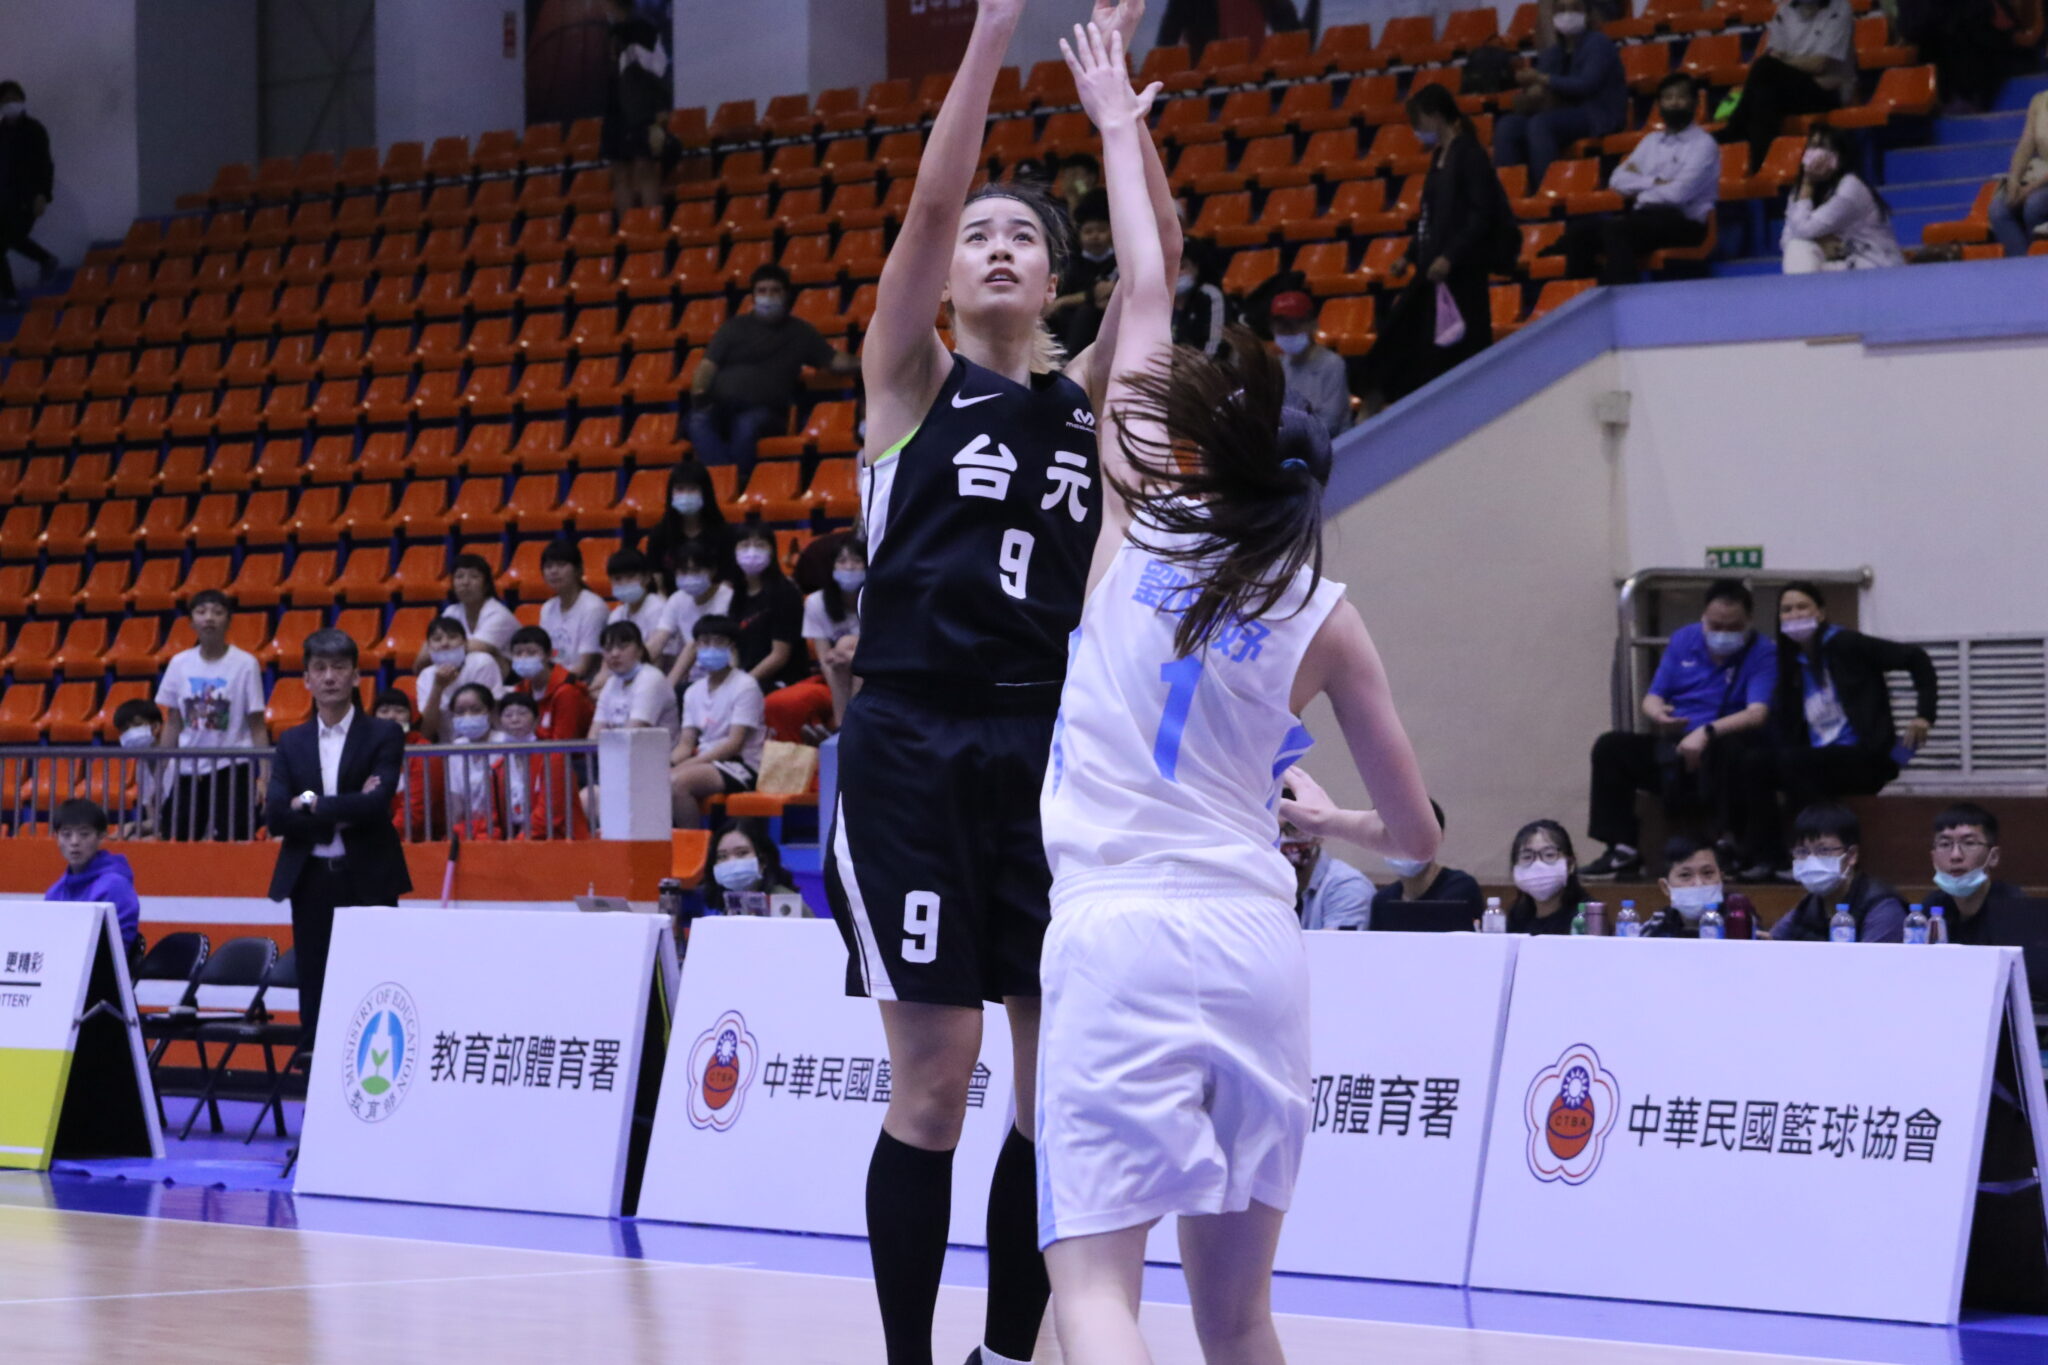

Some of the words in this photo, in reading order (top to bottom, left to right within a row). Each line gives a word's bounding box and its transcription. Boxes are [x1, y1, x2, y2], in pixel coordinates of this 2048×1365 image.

[952, 433, 1092, 523] 台元
[999, 528, 1035, 600] 9
[1153, 655, 1204, 784] 1
[901, 890, 941, 964] 9
[4, 951, 44, 974] 更精彩
[0, 993, 31, 1008] TTERY
[430, 1031, 621, 1092] 教育部體育署
[763, 1053, 992, 1109] 中華民國籃會
[1554, 1115, 1588, 1128] CTBA
[1628, 1094, 1942, 1163] 中華民國籃球協會
